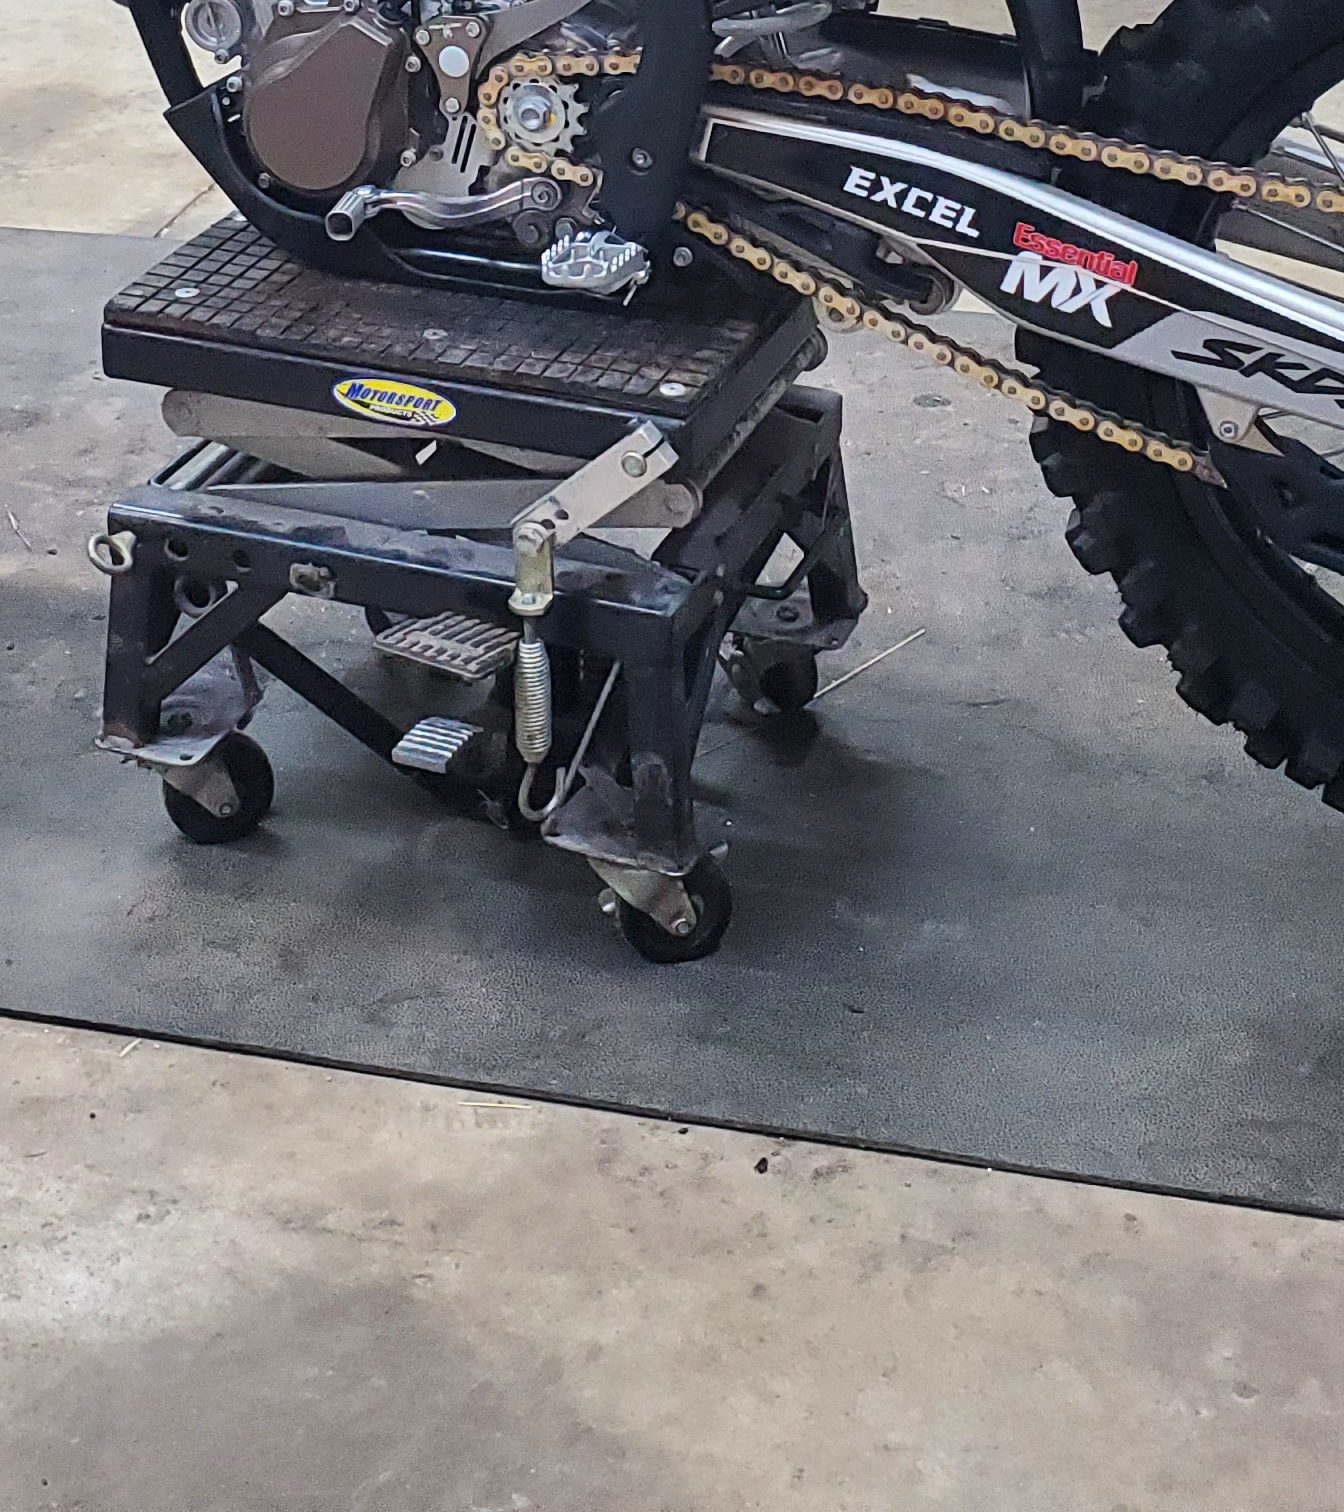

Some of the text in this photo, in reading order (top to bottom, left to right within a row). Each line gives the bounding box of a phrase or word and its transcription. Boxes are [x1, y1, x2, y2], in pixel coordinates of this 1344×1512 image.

[843, 165, 981, 238] EXCEL
[1013, 221, 1137, 286] Essential
[1000, 251, 1121, 328] MX
[345, 382, 444, 412] MOTORSPORT
[368, 404, 413, 418] PRODUCTS
